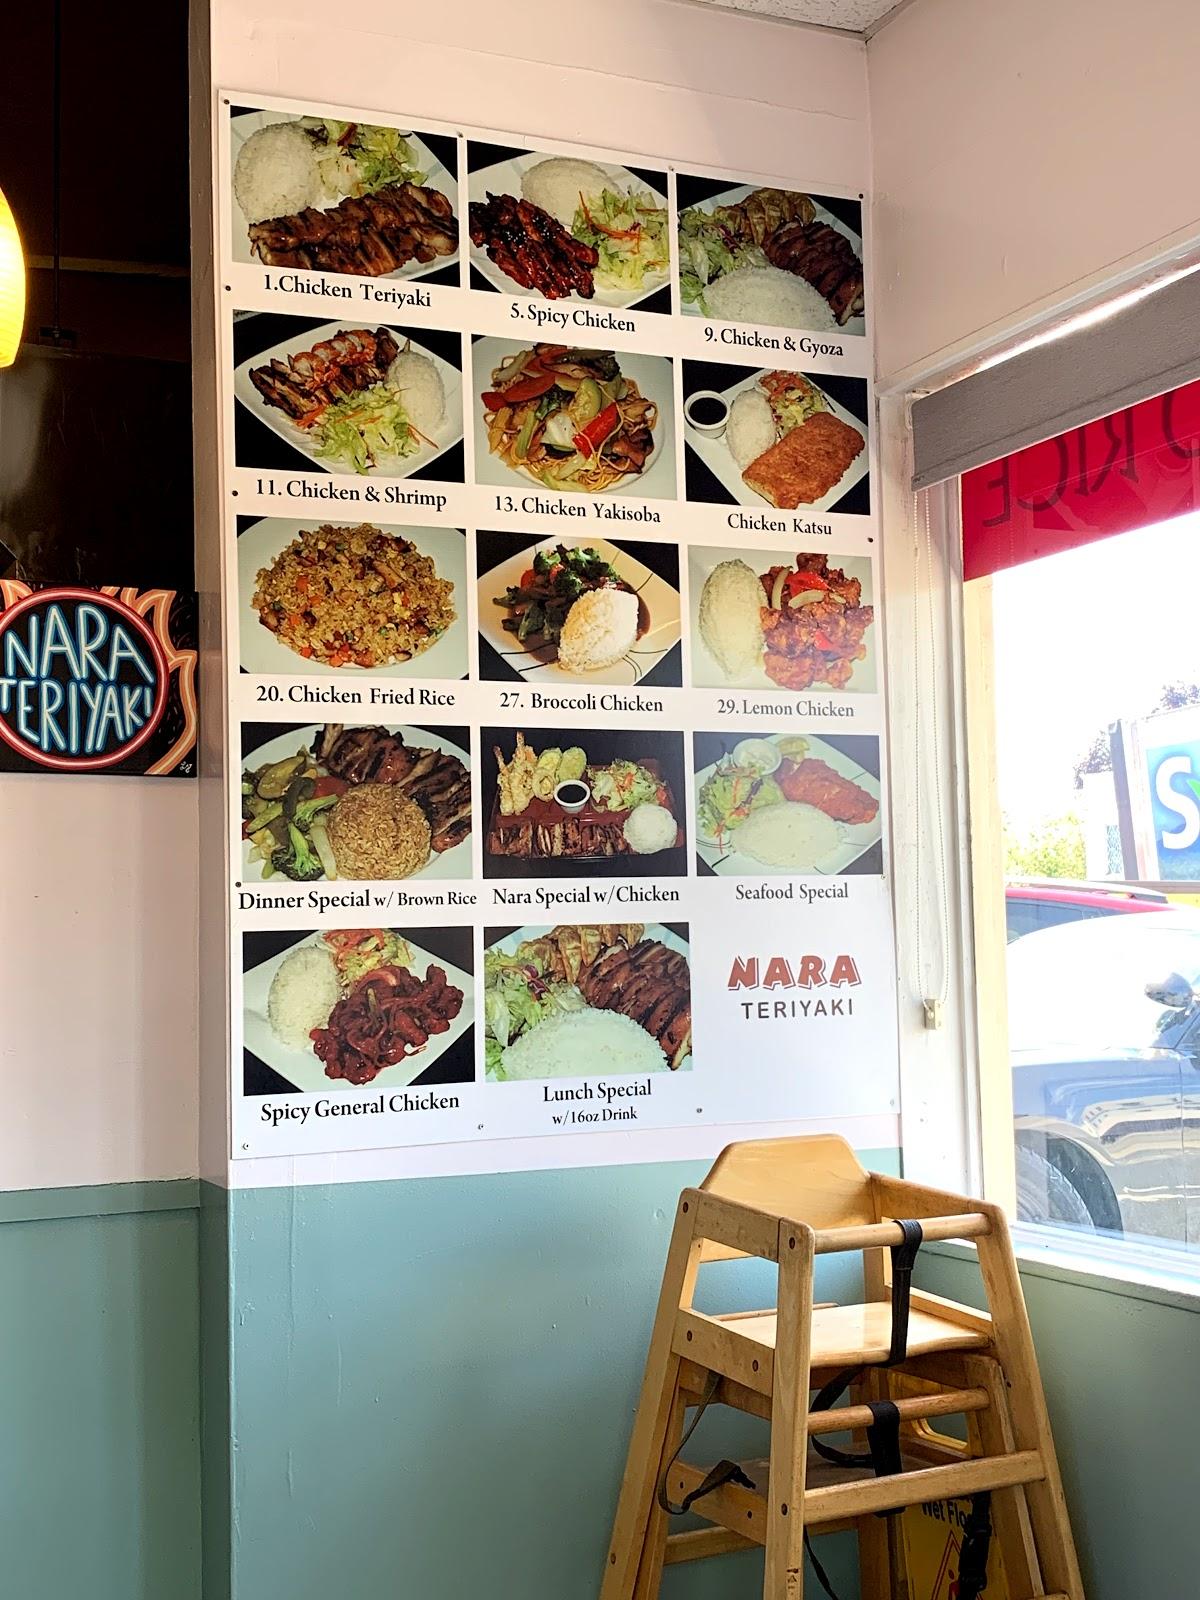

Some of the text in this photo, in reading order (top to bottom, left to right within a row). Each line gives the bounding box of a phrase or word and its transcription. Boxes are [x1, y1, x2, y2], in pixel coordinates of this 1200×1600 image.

[360, 284, 430, 309] Teriyaki
[511, 303, 635, 331] 5. Spicy Chicken
[705, 327, 843, 358] 9. Chicken & Gyoza
[257, 479, 446, 512] 11. Chicken & Shrimp
[497, 496, 660, 522] 13. Chicken Yakisoba
[728, 514, 831, 534] Chicken Katsu
[6, 606, 154, 682] NARA
[257, 685, 454, 705] 20. Chicken Fried Rice
[501, 693, 662, 711] 27. Broccoli Chicken
[0, 680, 151, 752] TERIYAKI
[718, 699, 854, 716] 29. Lemon Chicken
[239, 889, 476, 913] Dinner Special w/ Brown Rice
[493, 889, 531, 904] Nara
[536, 886, 590, 909] Special
[736, 883, 848, 904] Seafood Special
[728, 956, 861, 991] NARA
[741, 999, 852, 1019] TERIYAKI
[544, 1079, 651, 1103] Lunch Special
[261, 1092, 459, 1126] Spicy General Chicken
[603, 1106, 637, 1120] Drink
[947, 1499, 972, 1529] Flo
